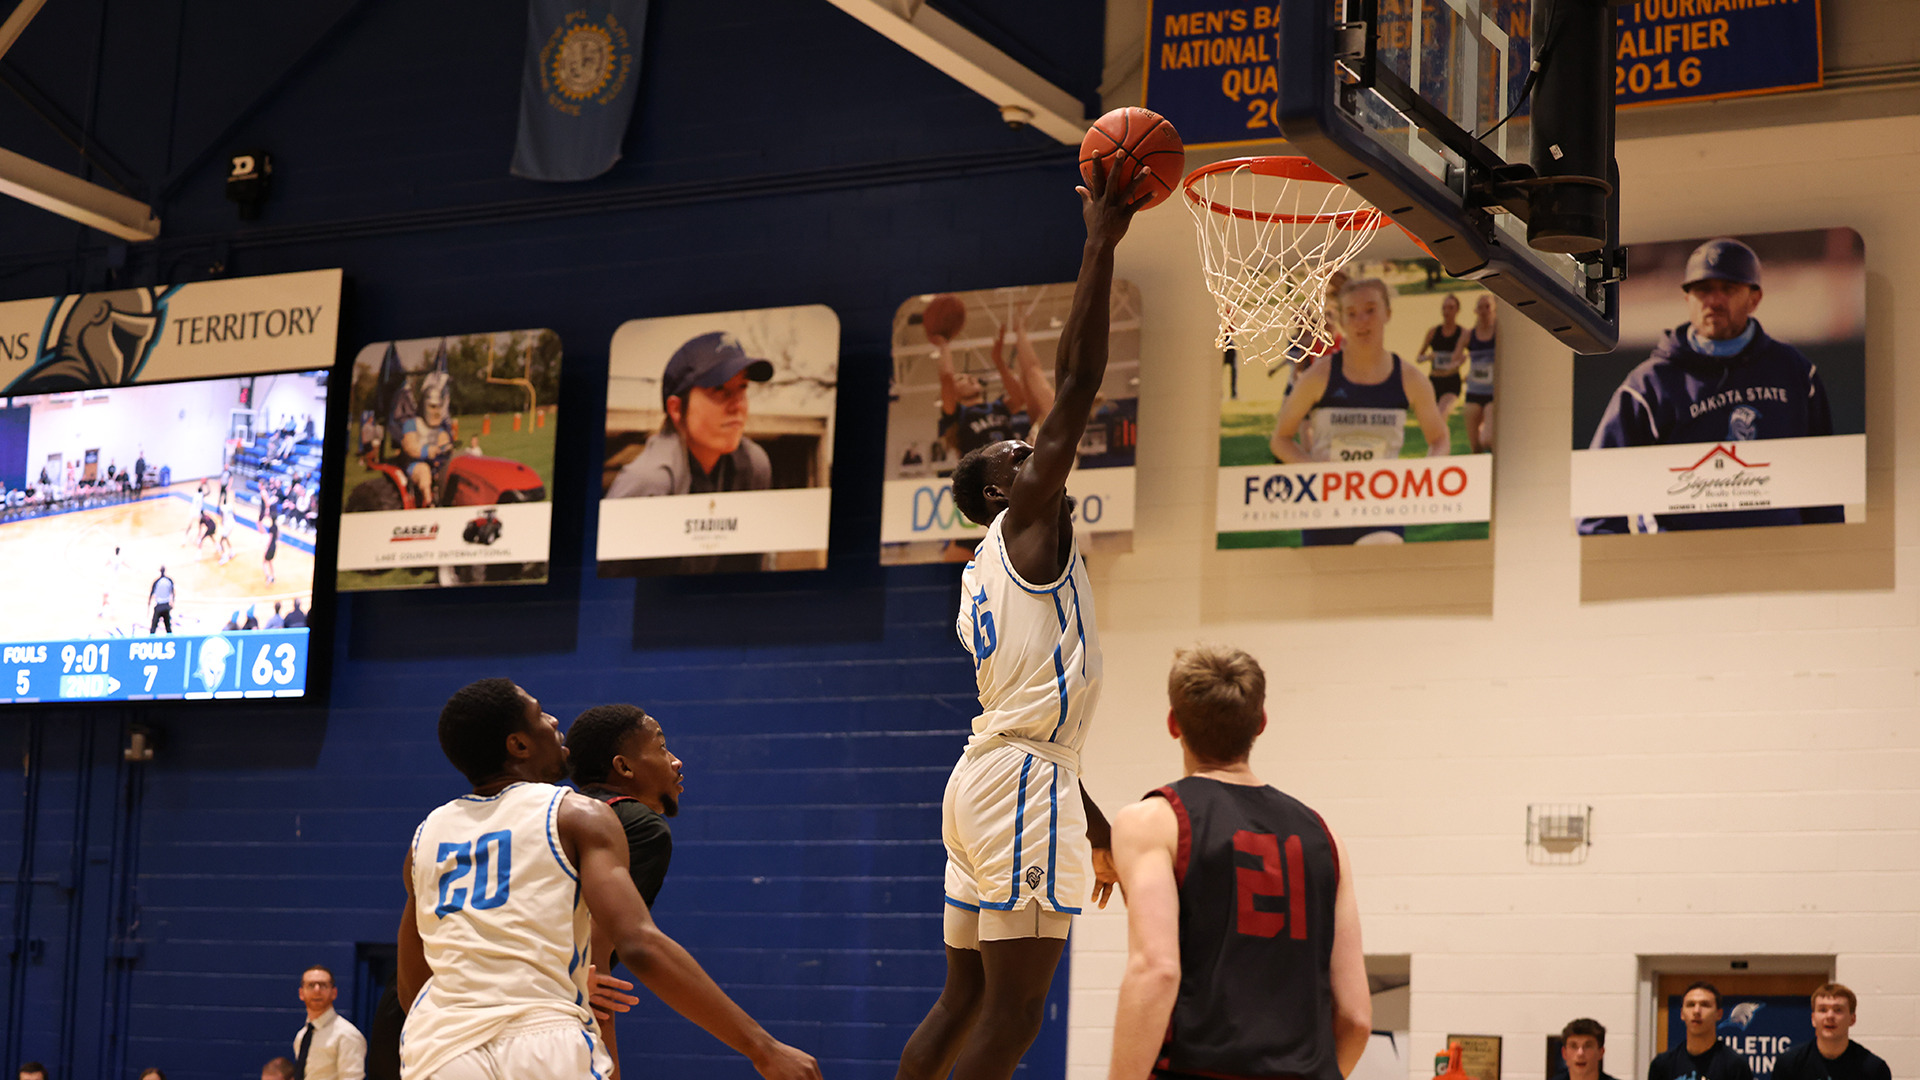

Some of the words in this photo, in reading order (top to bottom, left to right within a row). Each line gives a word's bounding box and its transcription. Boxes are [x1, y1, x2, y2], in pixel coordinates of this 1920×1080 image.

[1165, 9, 1248, 37] MEN'S
[1633, 0, 1801, 23] TOURN
[1161, 34, 1270, 70] NATIONAL
[173, 305, 322, 346] TERRITORY
[1689, 389, 1743, 418] DAKOTA
[1746, 387, 1788, 403] STATE
[1242, 508, 1322, 521] PRINTING
[1351, 502, 1465, 516] PROMOTIONS
[392, 525, 426, 537] CASE
[684, 517, 738, 534] STADIUM
[3, 645, 47, 664] FOULS
[61, 643, 110, 674] 9:01
[129, 641, 176, 660] FOULS
[252, 642, 296, 686] 63
[16, 669, 30, 695] 5
[143, 665, 158, 692] 7
[435, 829, 512, 920] 20
[1232, 829, 1308, 940] 21
